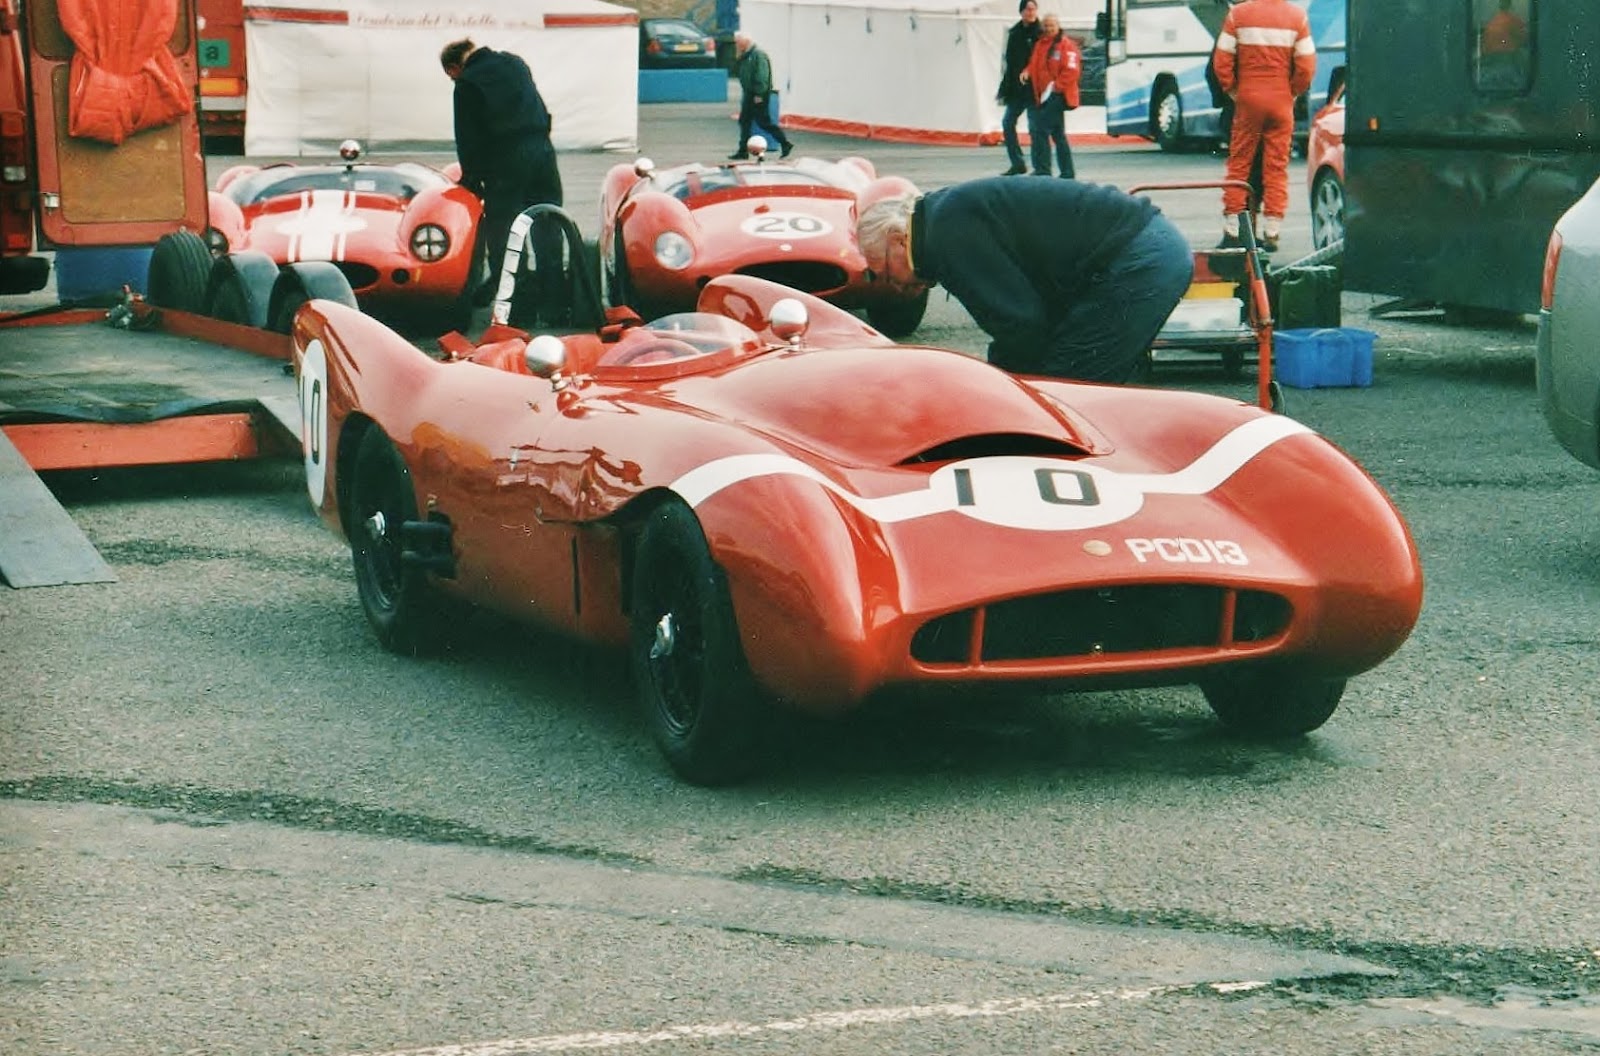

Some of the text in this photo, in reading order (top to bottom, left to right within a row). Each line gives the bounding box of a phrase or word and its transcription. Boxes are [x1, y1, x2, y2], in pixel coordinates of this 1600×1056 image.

[754, 216, 823, 233] 20
[953, 467, 1101, 507] 10
[1124, 536, 1250, 566] PCD13
